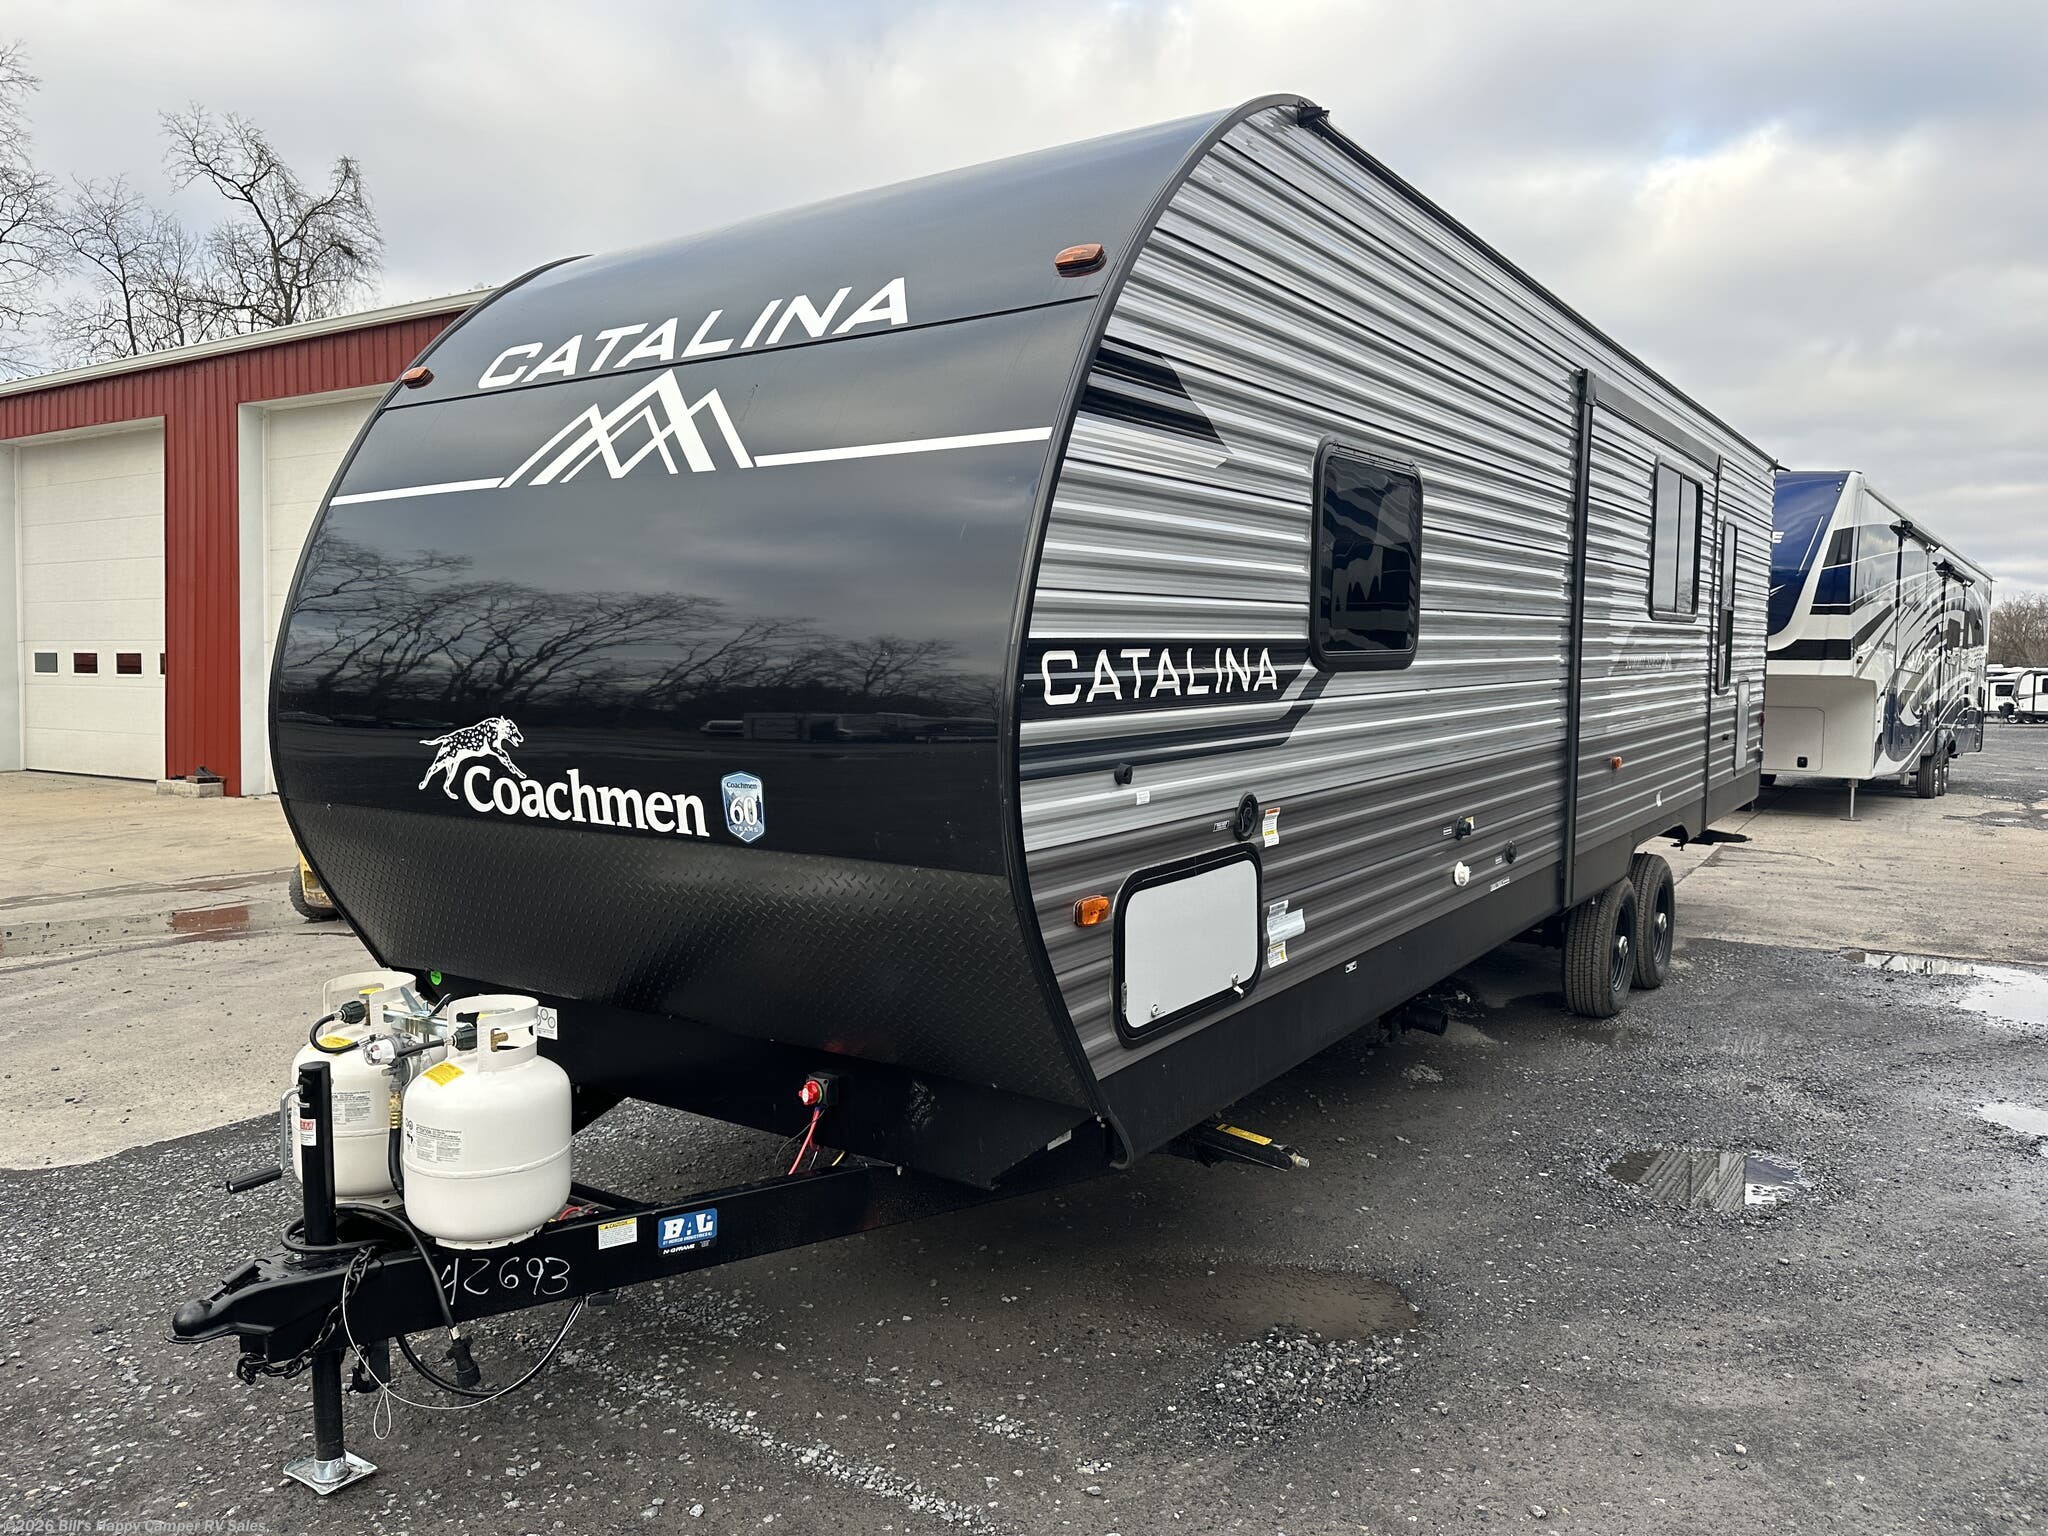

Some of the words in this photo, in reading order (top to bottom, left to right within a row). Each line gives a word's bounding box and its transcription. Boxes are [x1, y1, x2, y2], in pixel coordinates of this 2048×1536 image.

[478, 276, 909, 390] CATALINA
[1041, 647, 1278, 706] CATALINA
[463, 766, 711, 838] Coachmen
[726, 781, 758, 790] Coachmen
[729, 796, 758, 826] 60
[663, 1213, 714, 1241] BAL
